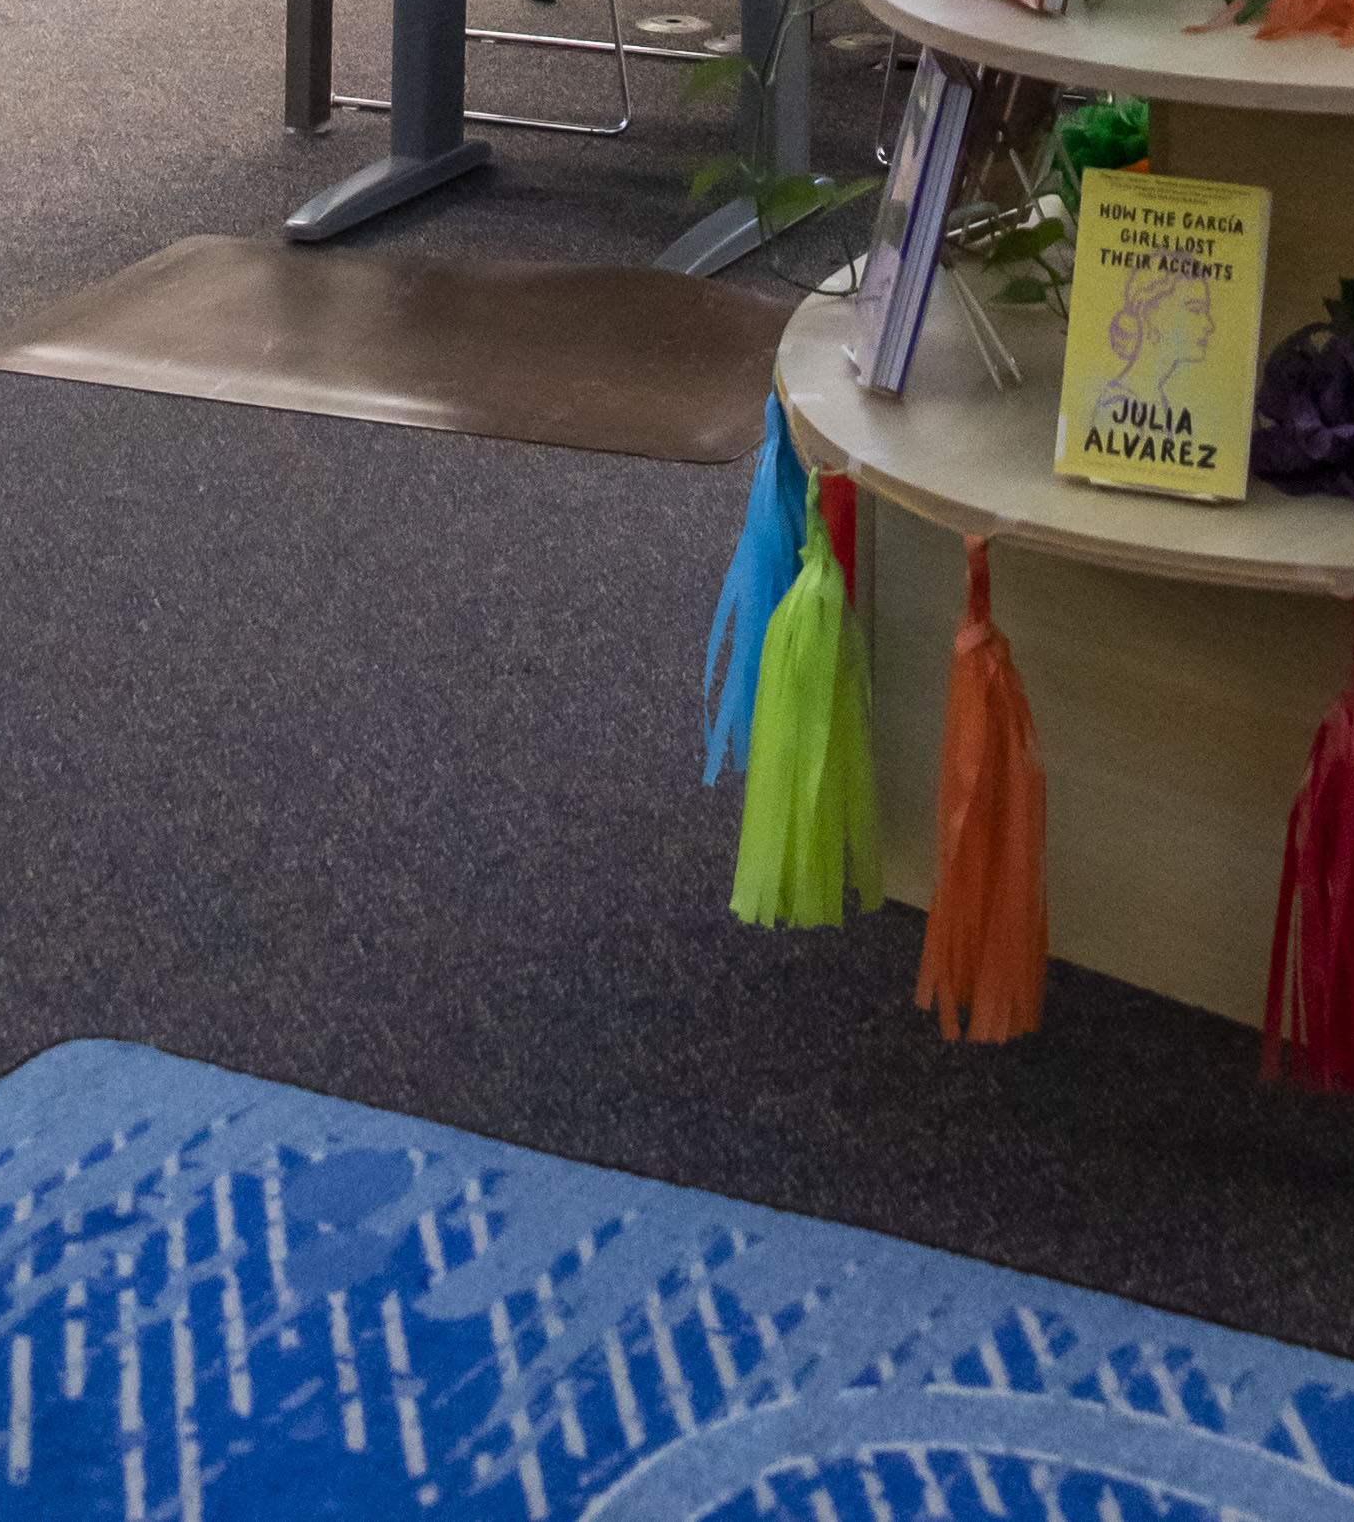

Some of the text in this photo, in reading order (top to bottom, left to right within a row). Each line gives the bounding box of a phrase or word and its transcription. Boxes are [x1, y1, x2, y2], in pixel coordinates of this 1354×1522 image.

[1099, 203, 1244, 235] HOW THE GARCÍA
[1120, 229, 1216, 257] GIRLS LOST
[1100, 248, 1233, 281] THEIR ACCENTS
[1112, 399, 1192, 436] JULIA
[1084, 426, 1218, 469] ALVAREZ
